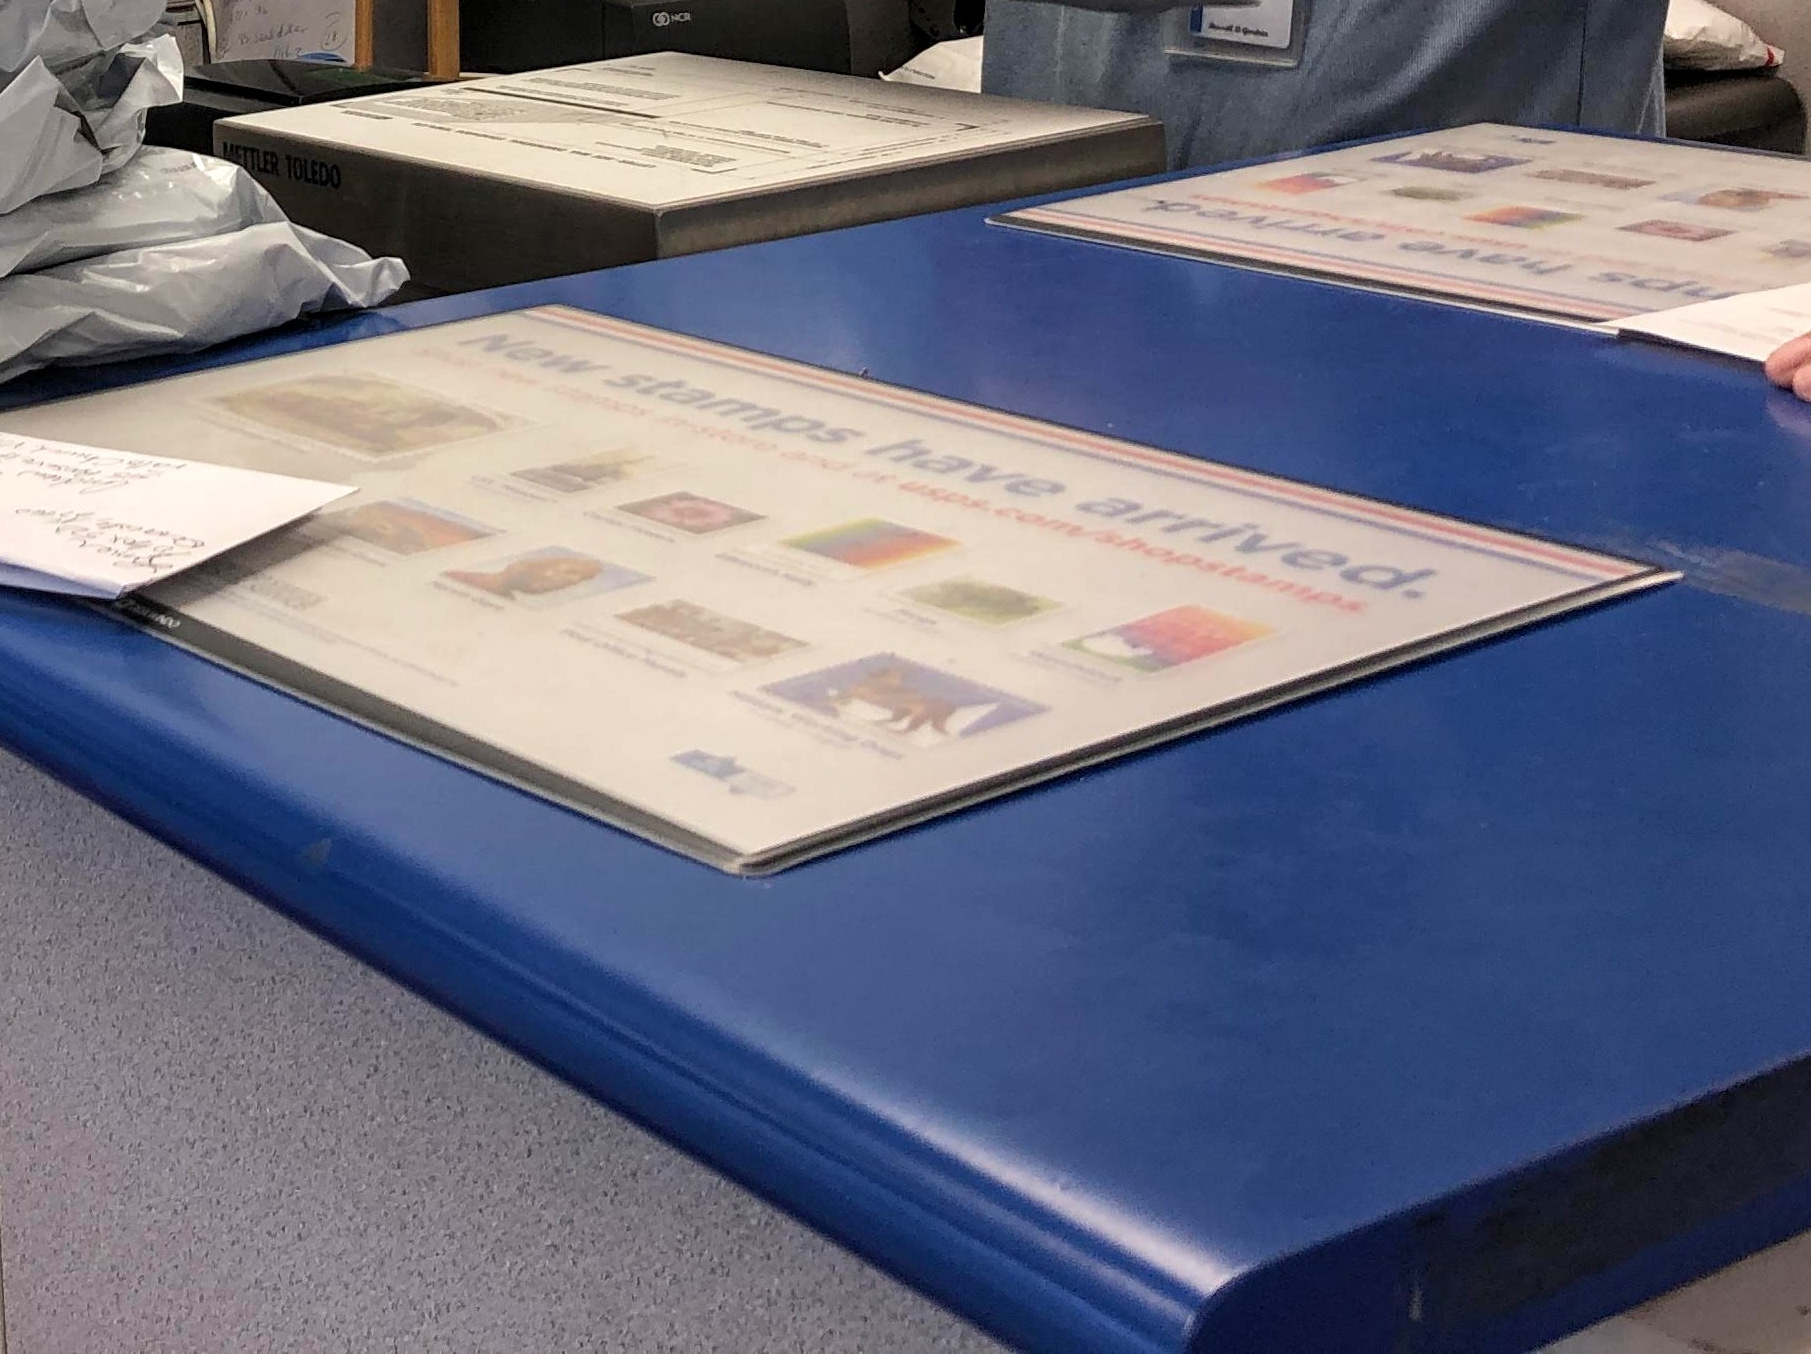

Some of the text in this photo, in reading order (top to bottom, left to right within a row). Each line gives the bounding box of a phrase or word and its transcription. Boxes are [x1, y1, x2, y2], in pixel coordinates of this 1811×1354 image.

[670, 12, 692, 23] NCR
[222, 141, 342, 189] METTLER TOLEDO
[1396, 238, 1575, 278] have
[458, 332, 1439, 601] New stamps have arrived.
[897, 477, 1371, 616] usps.com/shopstamps
